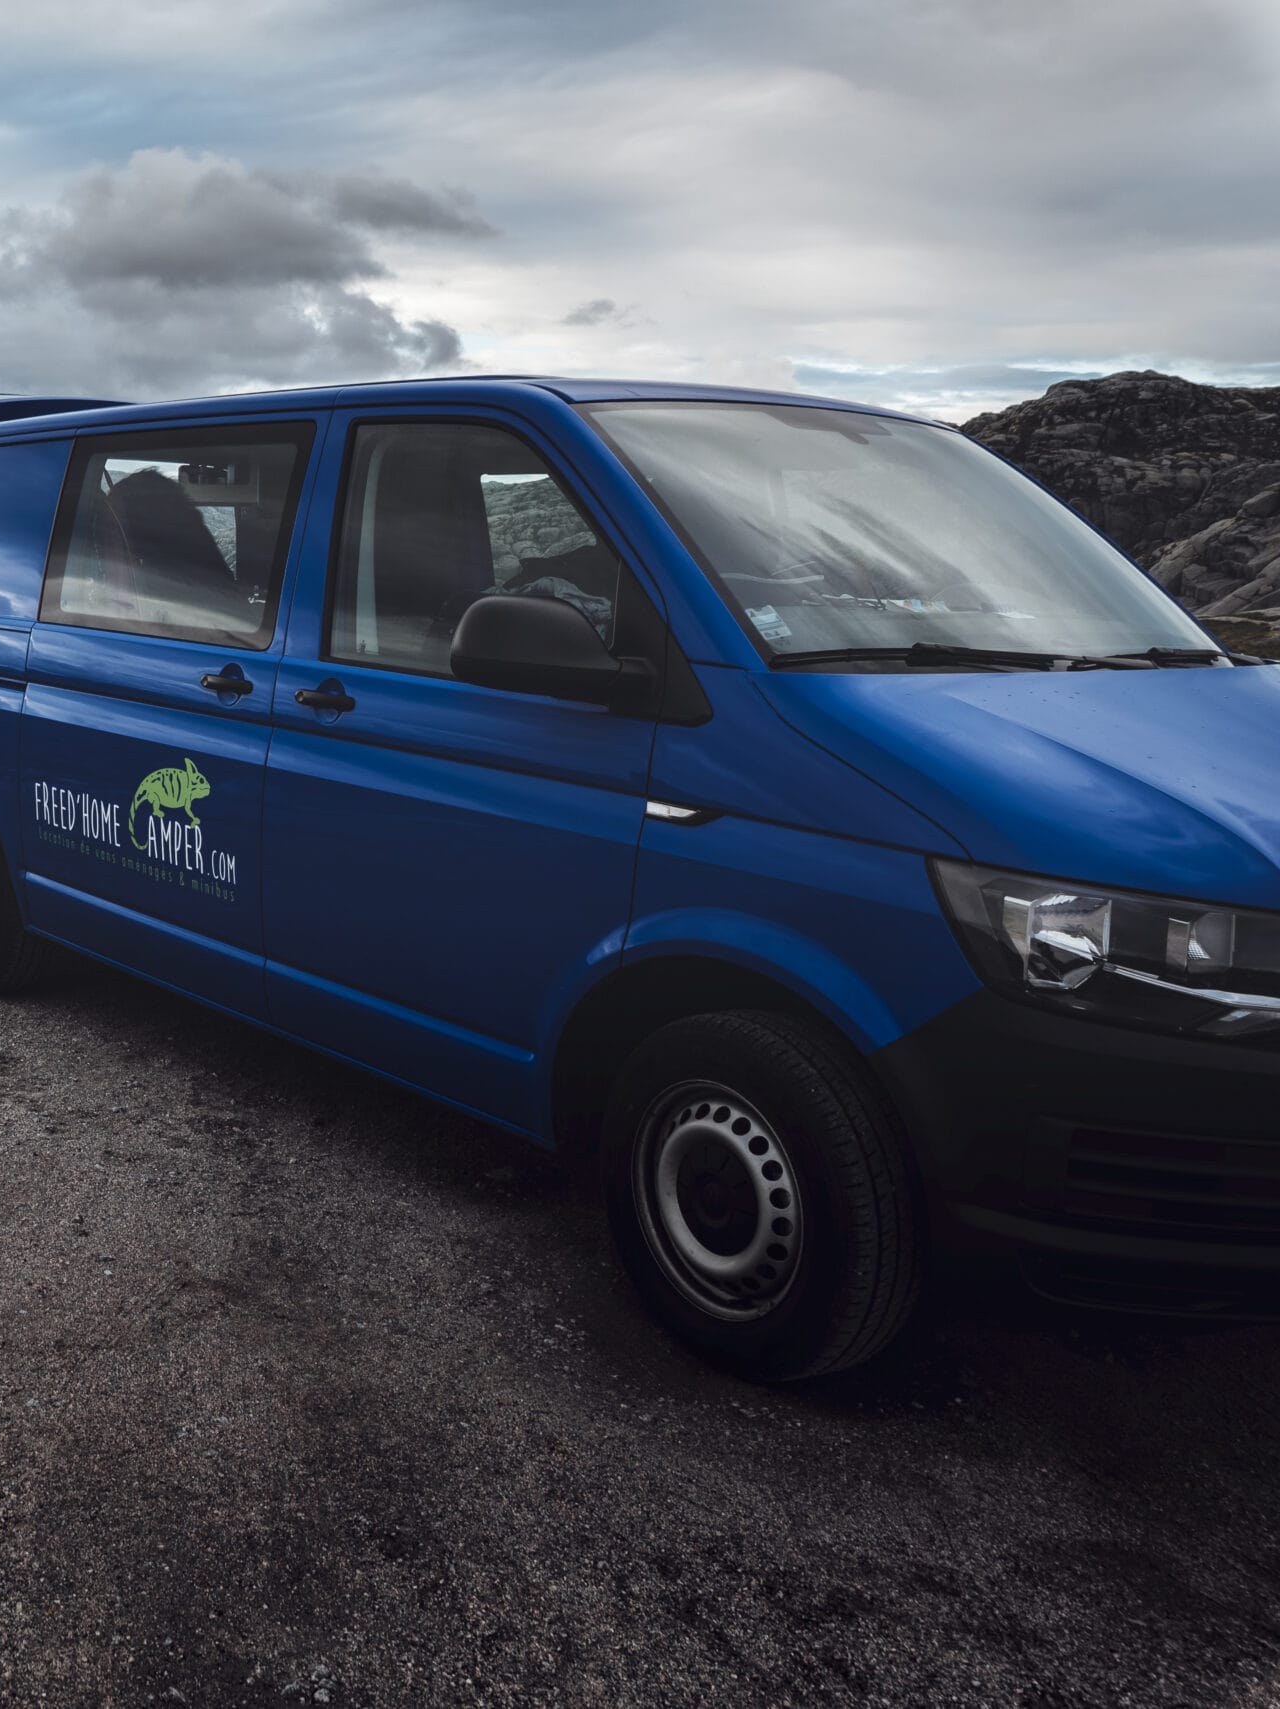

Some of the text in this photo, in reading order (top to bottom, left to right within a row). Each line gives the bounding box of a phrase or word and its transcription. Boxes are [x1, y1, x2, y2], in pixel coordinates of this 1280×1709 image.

[34, 781, 121, 848] FREED'HOME
[38, 827, 75, 849] Location
[80, 841, 90, 855] de
[95, 849, 116, 864] vans
[179, 872, 185, 887] &
[191, 879, 235, 902] minibus
